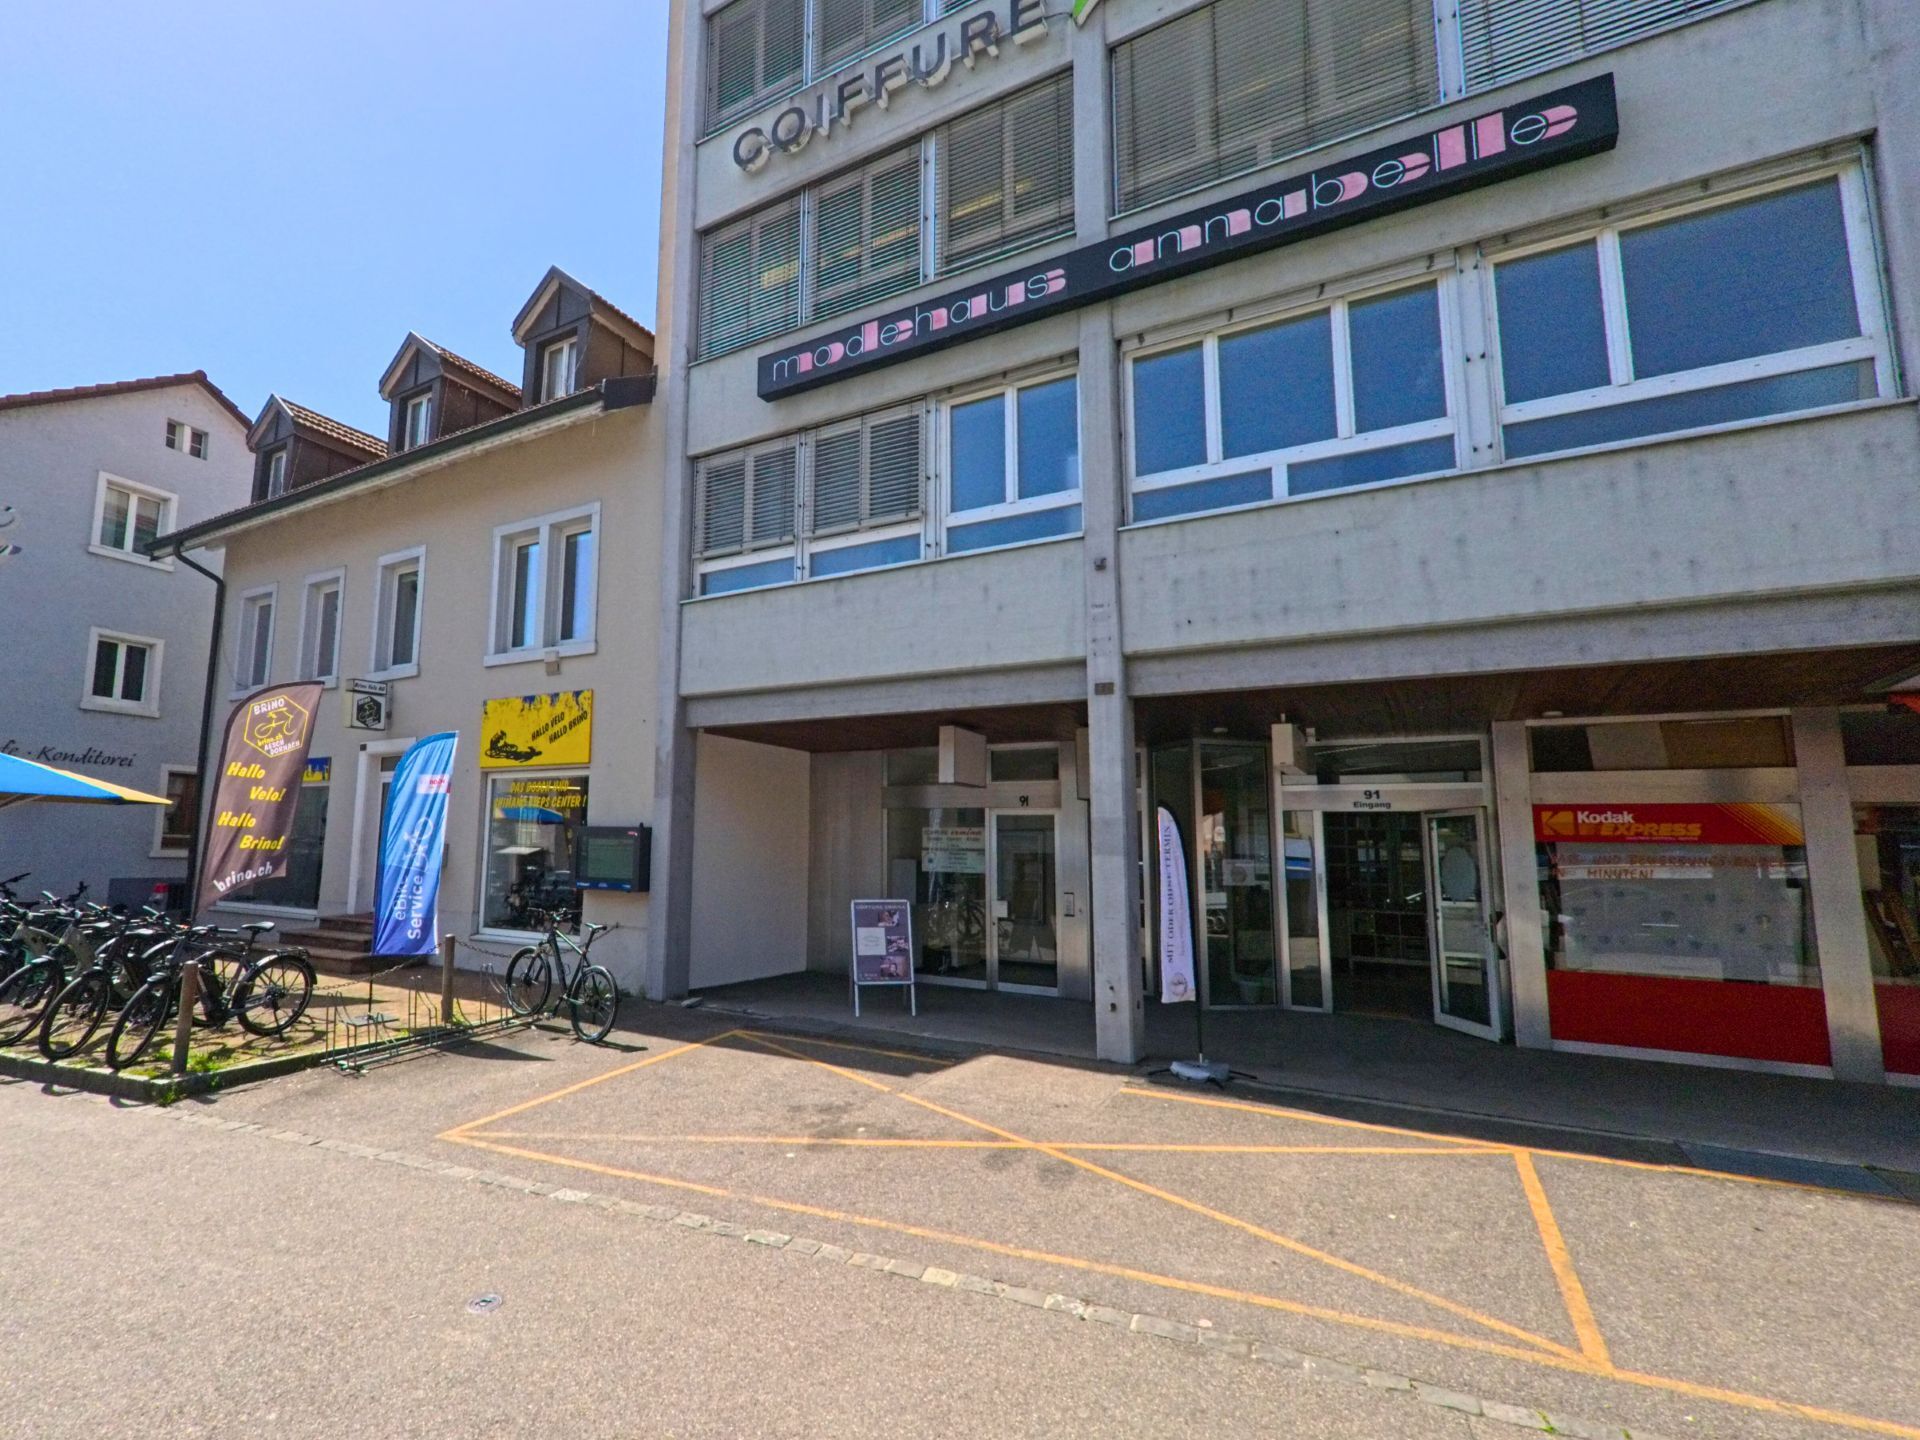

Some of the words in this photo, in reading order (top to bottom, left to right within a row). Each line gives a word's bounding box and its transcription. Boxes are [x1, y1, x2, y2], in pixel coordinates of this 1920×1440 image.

[732, 0, 1048, 173] COIFFURE
[773, 268, 1066, 381] modehaus
[1110, 105, 1577, 272] annabelle
[253, 698, 285, 715] BRINO
[531, 723, 550, 741] HALLO
[550, 711, 565, 728] VELO
[548, 725, 568, 744] HALLO
[568, 710, 588, 730] BRINO
[36, 746, 137, 767] Konditorei
[226, 761, 266, 779] Hallo
[249, 786, 286, 802] Velo!
[551, 795, 581, 808] CENTER
[1019, 795, 1029, 807] 91
[1363, 789, 1380, 800] 91
[1353, 801, 1392, 810] Eingang
[217, 811, 256, 828] Hallo
[1577, 811, 1634, 824] Kodak
[1601, 823, 1702, 836] EXPRESS
[239, 835, 286, 850] Brino!
[213, 861, 273, 892] brino.ch
[1586, 868, 1653, 879] MINUTEN!
[407, 875, 423, 940] Service
[1166, 909, 1174, 940] ODER
[1166, 942, 1174, 964] MIT
